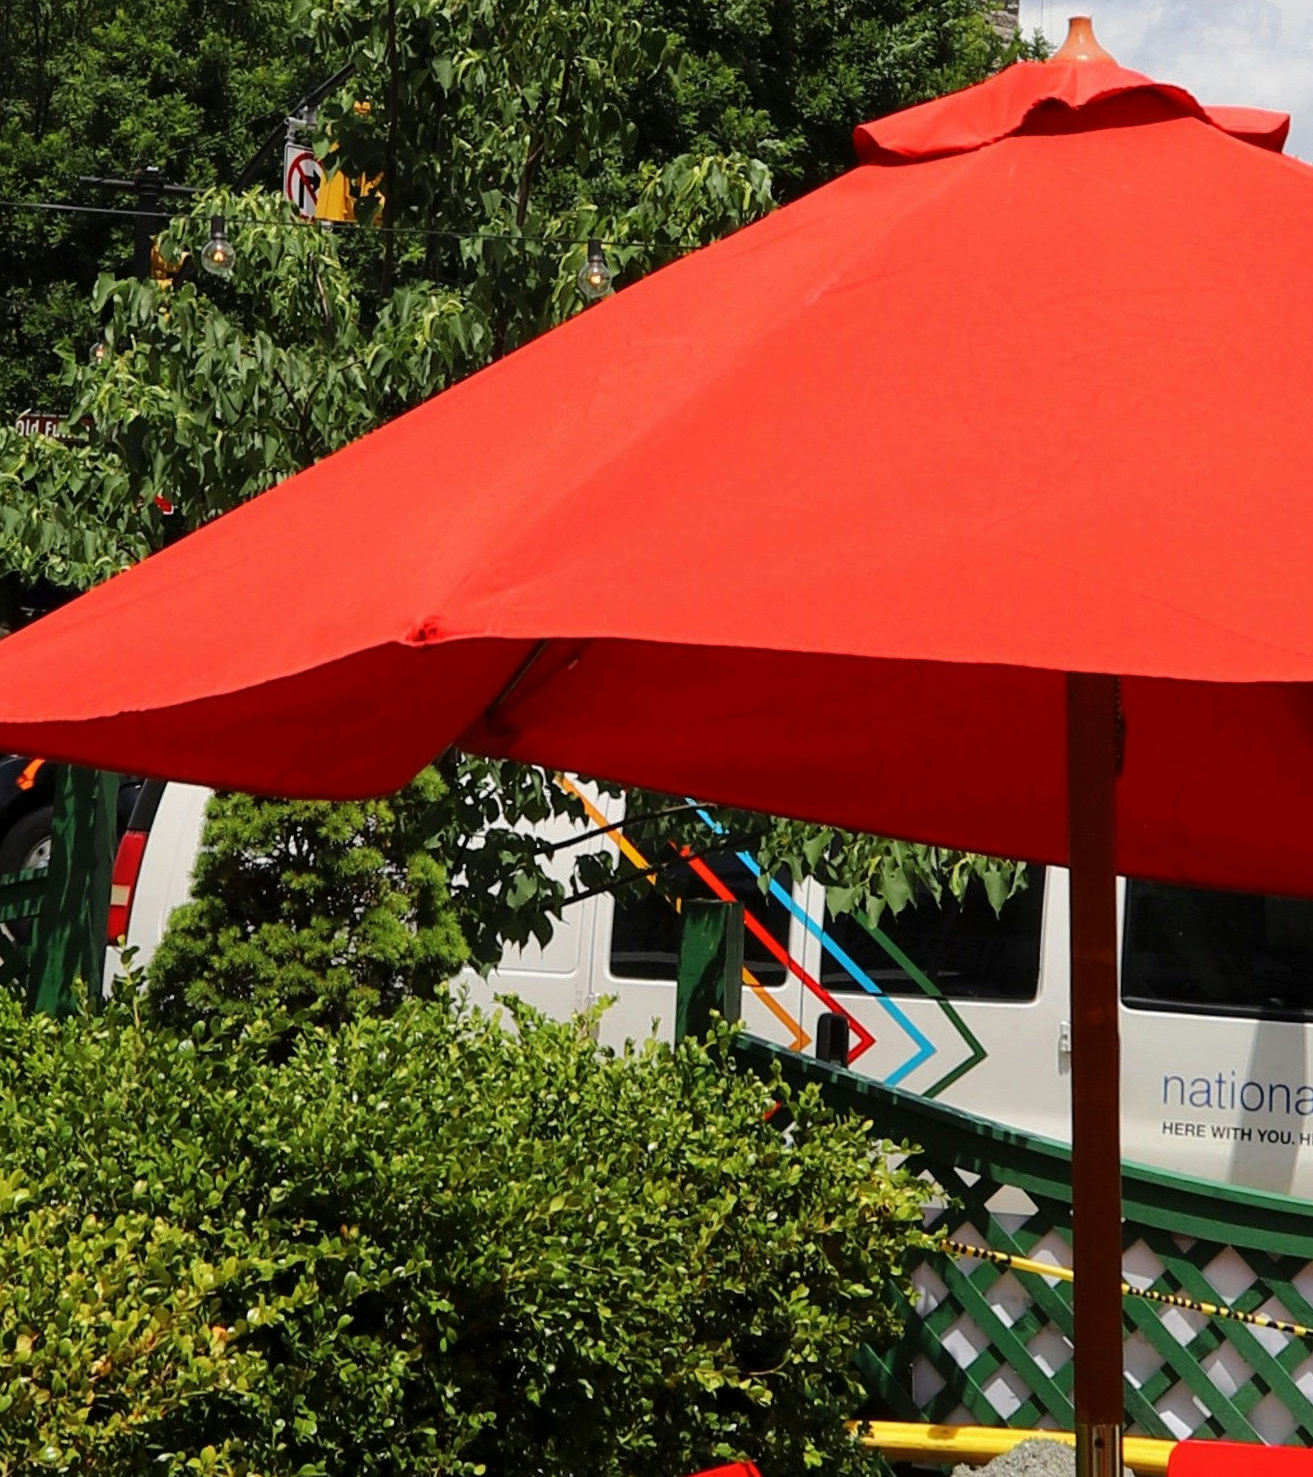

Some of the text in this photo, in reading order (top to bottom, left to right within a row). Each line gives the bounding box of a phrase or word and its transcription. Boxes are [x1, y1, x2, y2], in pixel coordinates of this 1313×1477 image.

[15, 419, 40, 437] Old
[1162, 1122, 1206, 1138] HERE
[1211, 1126, 1252, 1141] WITH
[1258, 1129, 1296, 1146] YOU.
